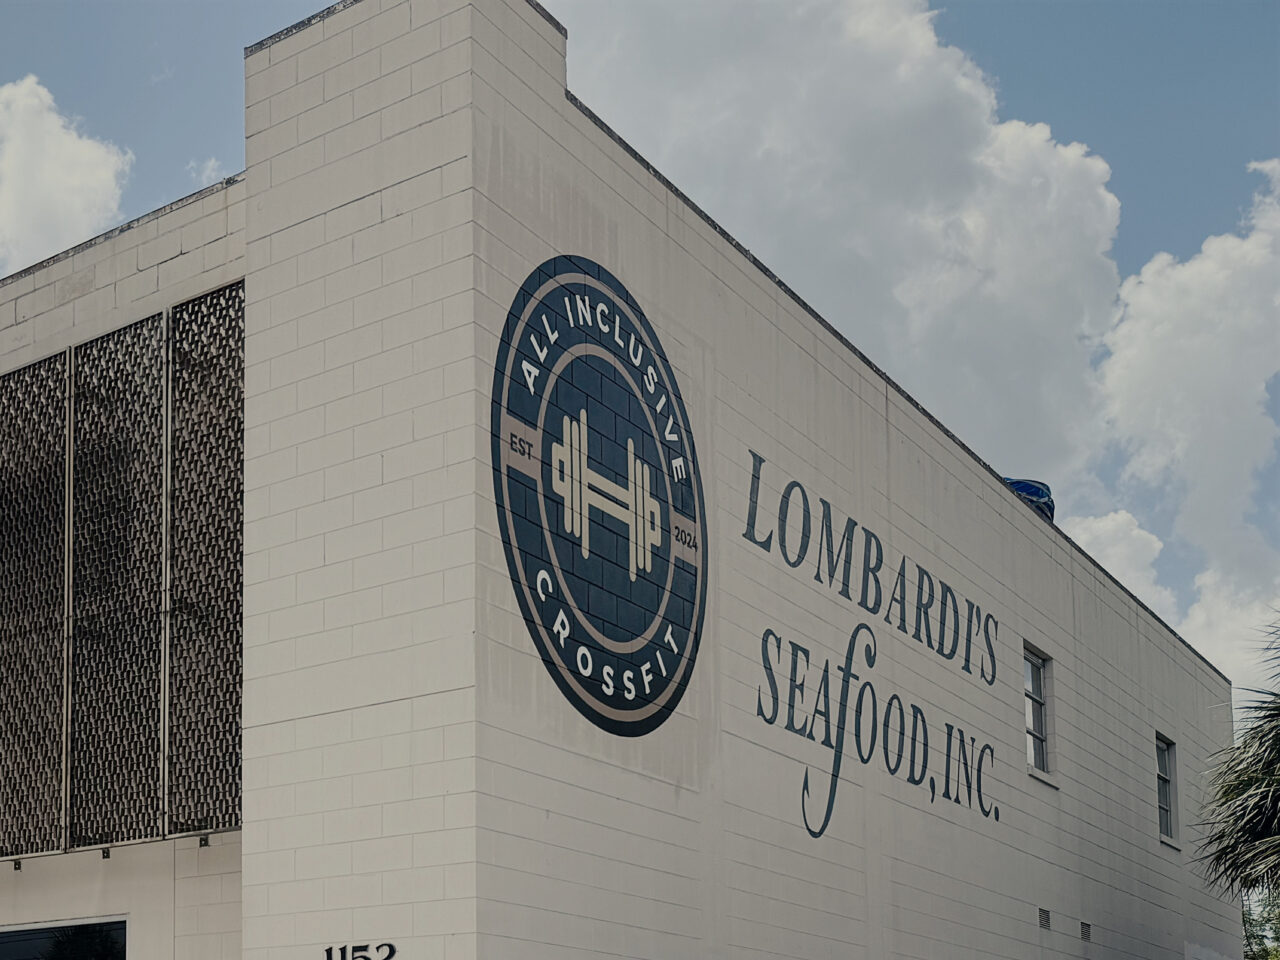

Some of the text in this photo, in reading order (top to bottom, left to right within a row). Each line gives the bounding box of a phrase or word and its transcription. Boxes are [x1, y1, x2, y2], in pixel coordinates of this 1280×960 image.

[521, 295, 687, 483] ALL INCLUSIVE
[674, 525, 698, 553] 2024
[742, 449, 999, 687] LOMBARDI'S
[536, 568, 681, 701] CROSSFIT
